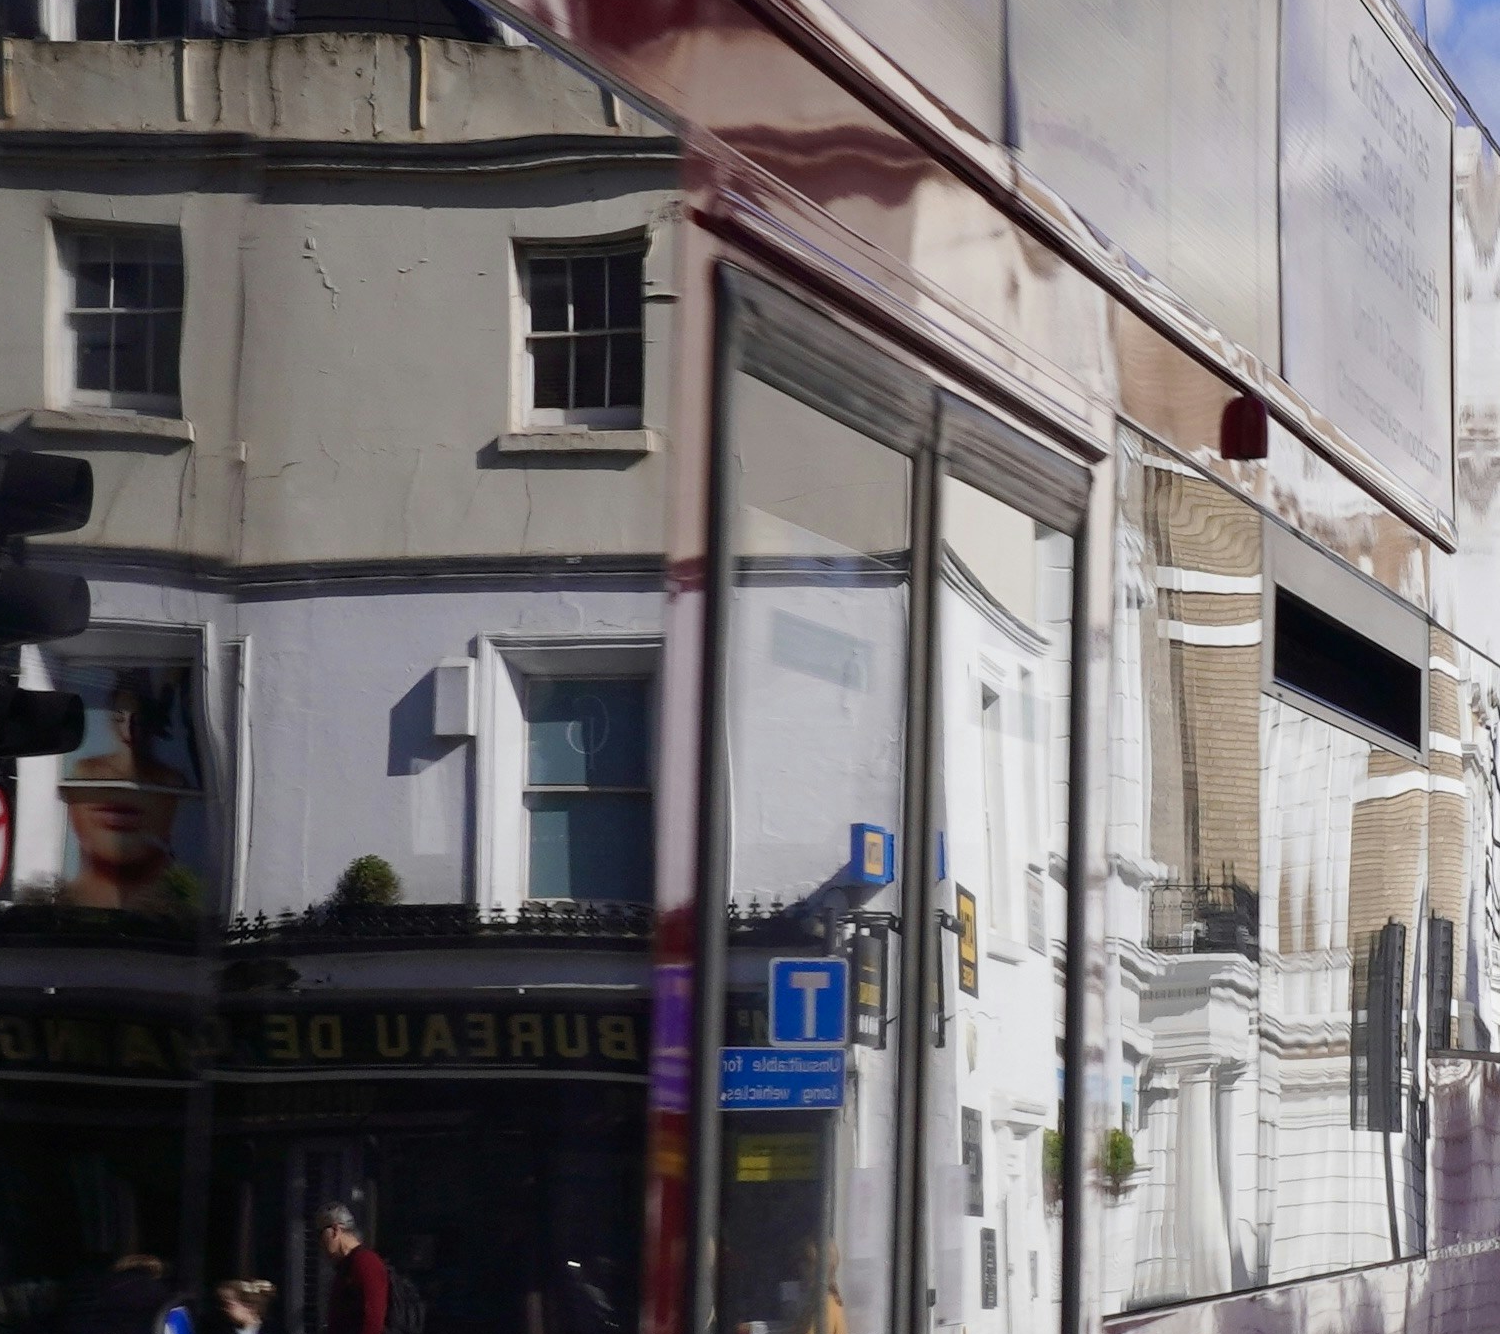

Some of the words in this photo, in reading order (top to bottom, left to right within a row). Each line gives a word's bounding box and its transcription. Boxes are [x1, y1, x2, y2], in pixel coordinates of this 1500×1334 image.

[1348, 29, 1407, 157] Christmas
[1410, 107, 1430, 185] has
[1406, 240, 1441, 331] Heath
